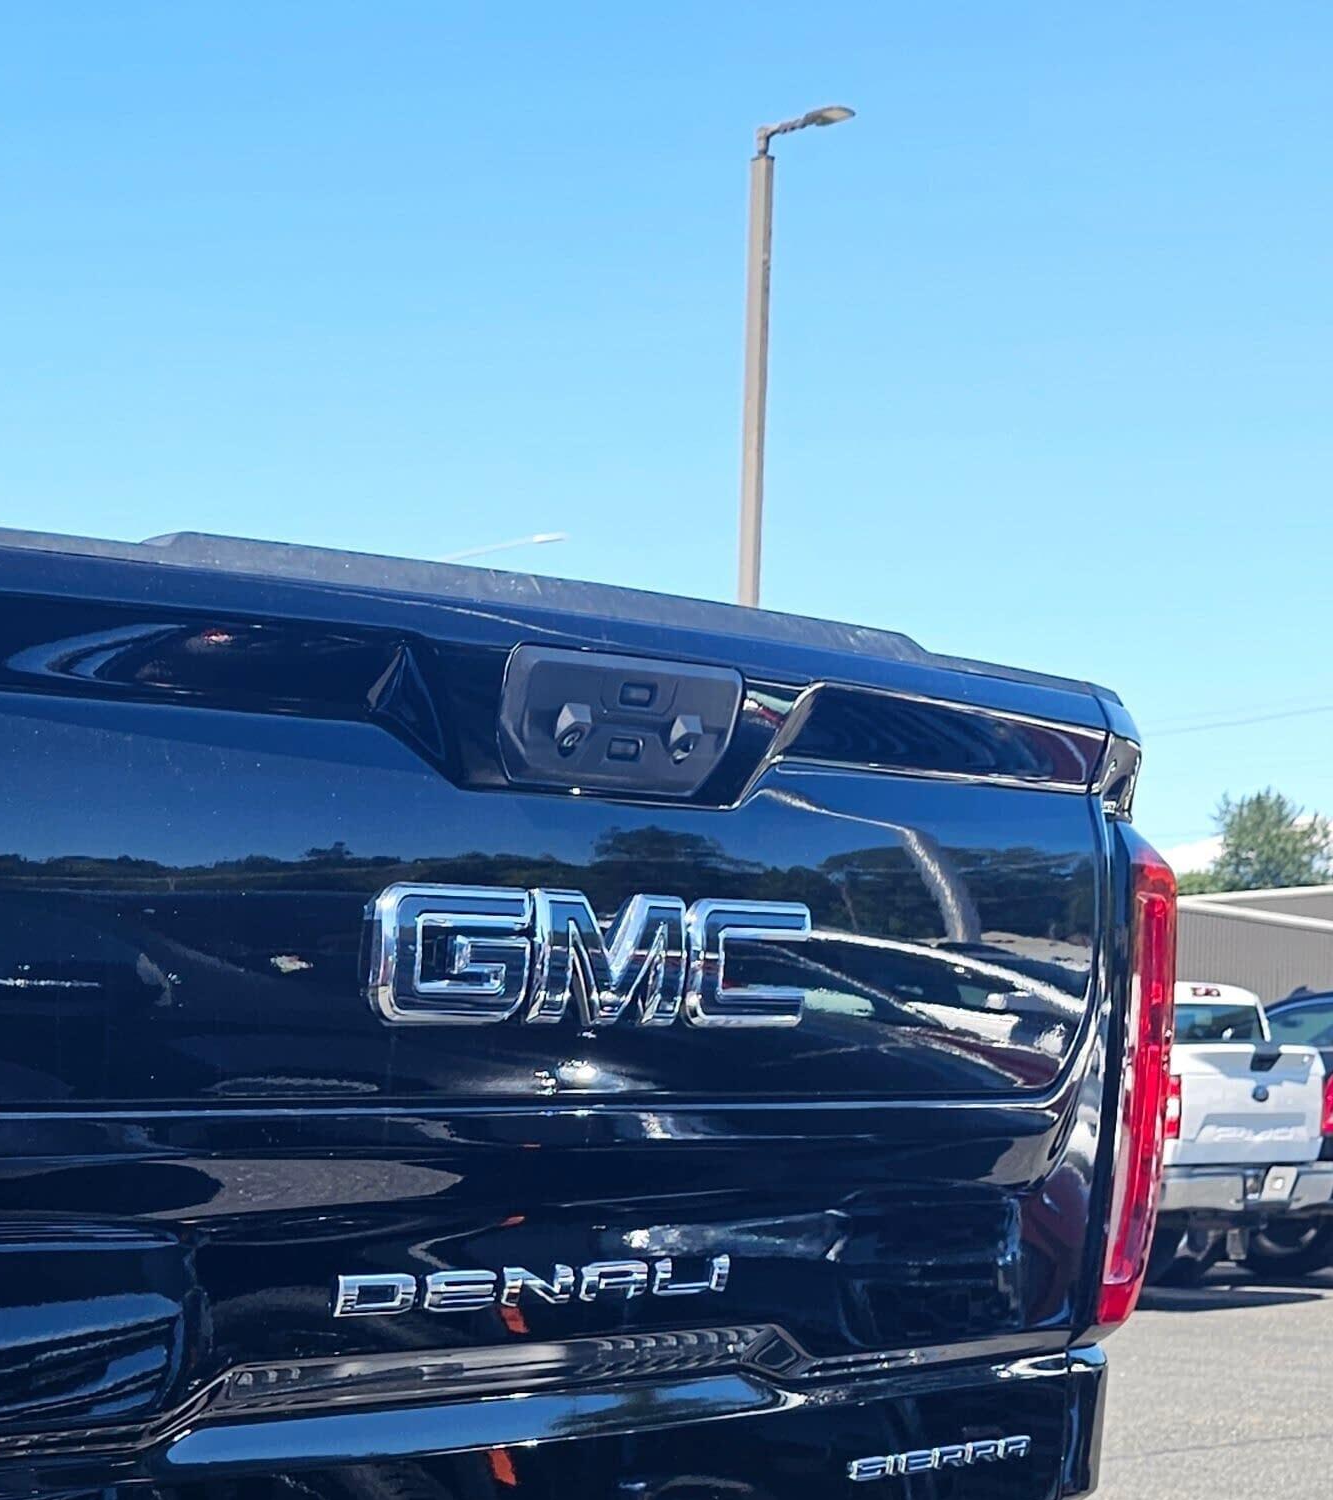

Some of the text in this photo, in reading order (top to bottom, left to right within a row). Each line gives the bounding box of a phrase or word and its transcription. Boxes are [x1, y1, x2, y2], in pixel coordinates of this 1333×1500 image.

[365, 880, 813, 1028] GMC
[332, 1253, 732, 1319] DENALI
[847, 1434, 1032, 1482] SIERRA
